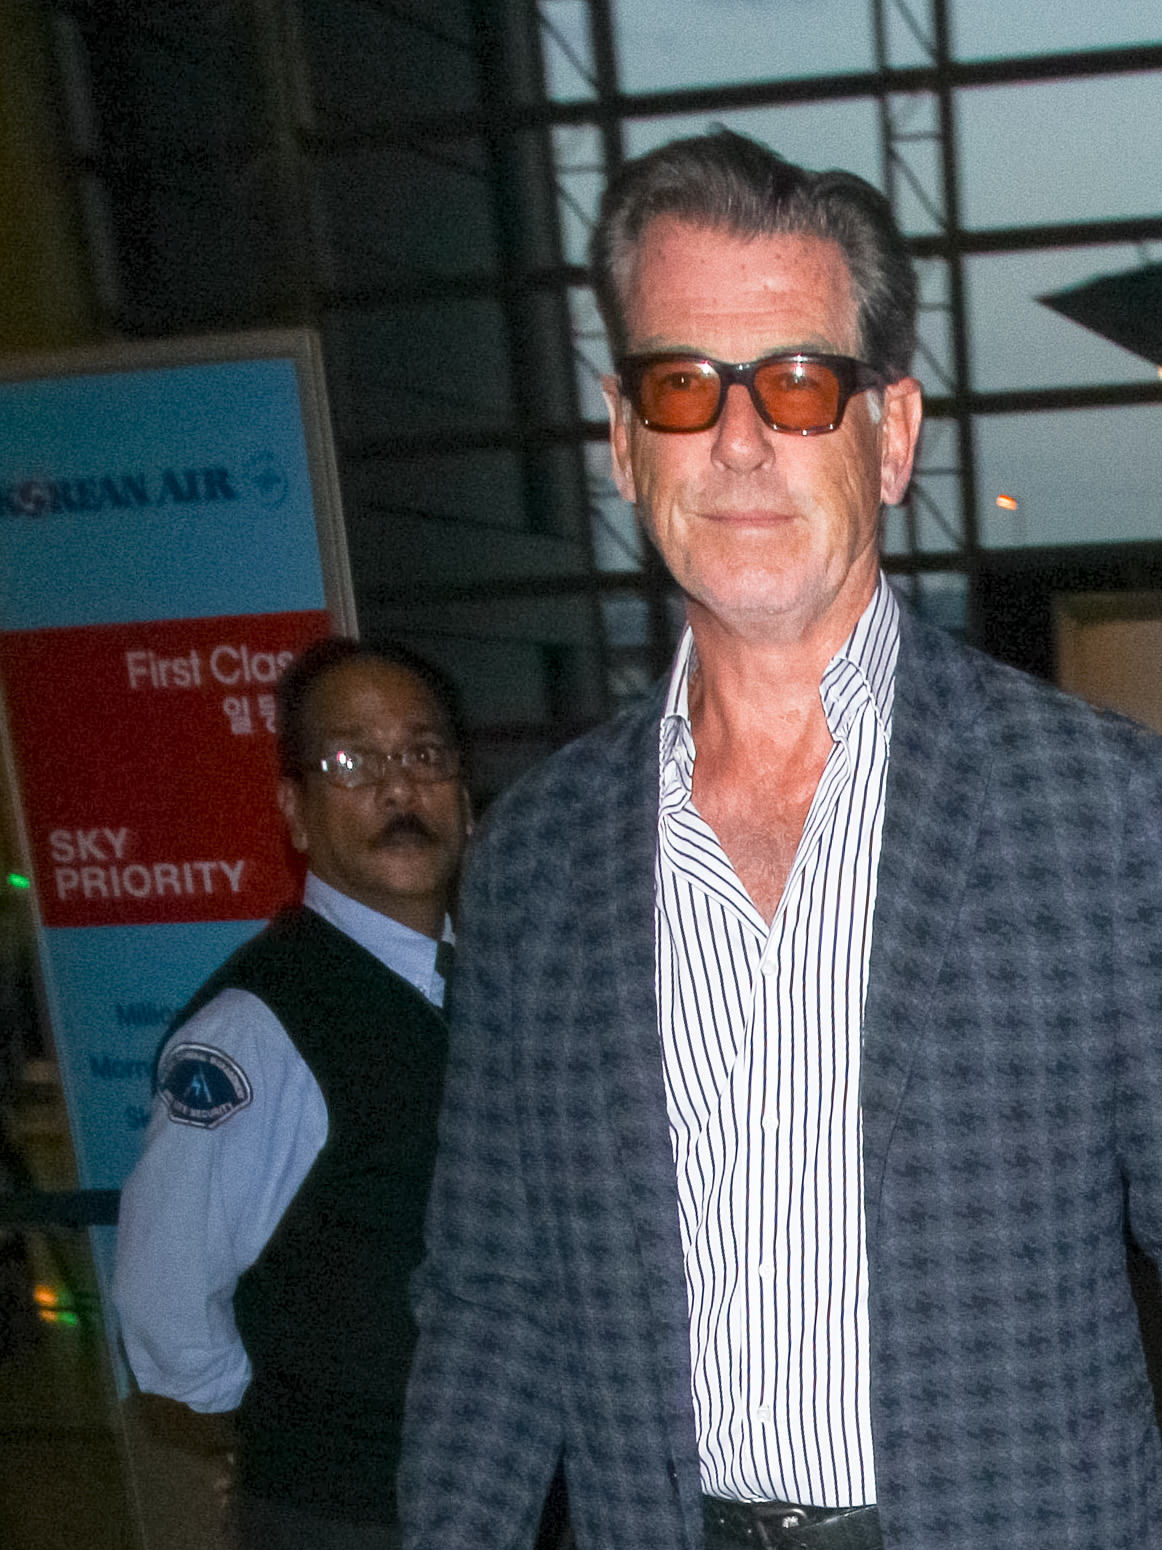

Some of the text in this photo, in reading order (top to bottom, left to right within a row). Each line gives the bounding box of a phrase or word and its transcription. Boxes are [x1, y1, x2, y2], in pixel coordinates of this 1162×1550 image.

[160, 466, 238, 503] AIR
[125, 644, 295, 690] First Clas
[49, 826, 130, 863] SKY
[55, 860, 245, 900] PRIORITY
